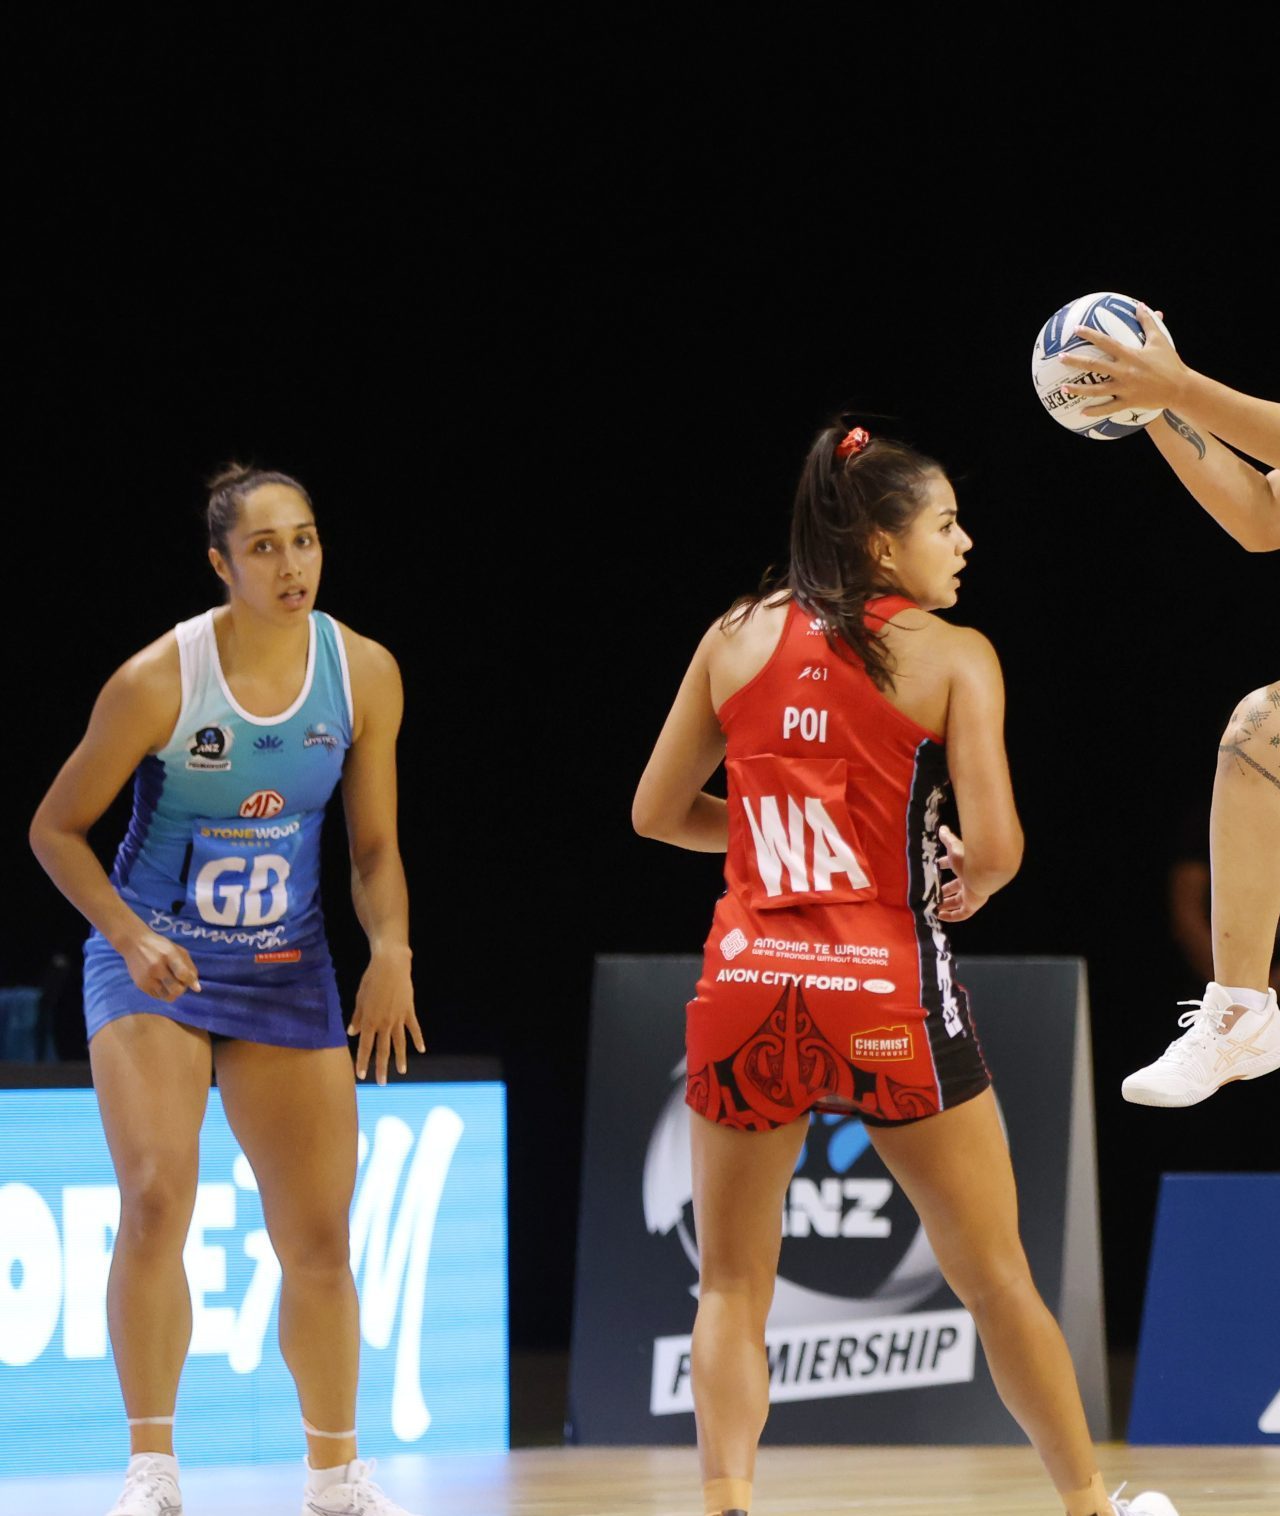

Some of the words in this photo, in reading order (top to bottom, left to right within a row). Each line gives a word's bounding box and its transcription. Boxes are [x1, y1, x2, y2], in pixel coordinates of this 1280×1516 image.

[812, 667, 828, 681] 61
[783, 706, 828, 743] POI
[742, 794, 872, 898] WA
[195, 853, 290, 927] GD
[753, 938, 809, 953] AMOHIA
[813, 943, 831, 955] TE
[834, 944, 889, 958] WAIORA
[776, 951, 816, 961] STRONGER
[817, 955, 851, 964] WITHOUT
[716, 969, 759, 984] AVON
[761, 971, 803, 988] CITY
[805, 975, 858, 992] FORD
[855, 1037, 909, 1051] CHEMIST
[783, 1178, 893, 1239] NZ
[671, 1325, 959, 1397] PMIERSHIP
